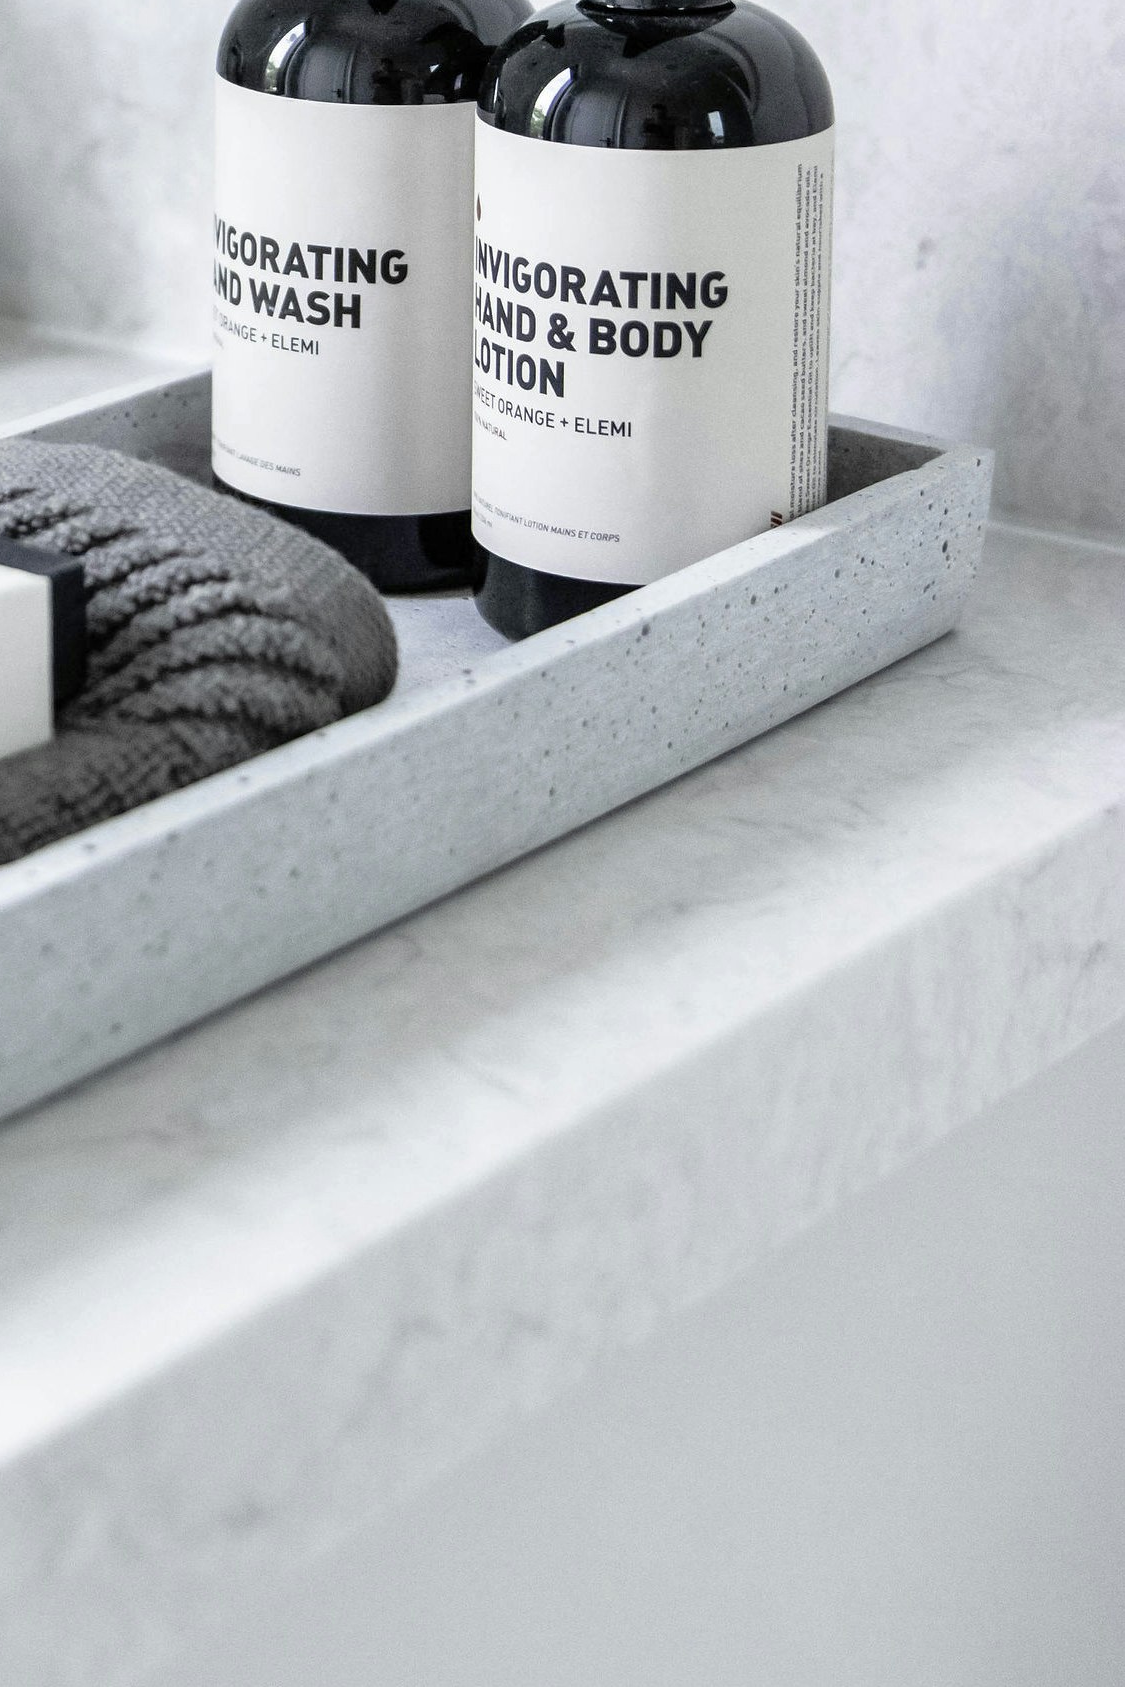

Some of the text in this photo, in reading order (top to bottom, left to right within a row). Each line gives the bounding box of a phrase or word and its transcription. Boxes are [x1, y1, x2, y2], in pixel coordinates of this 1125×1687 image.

[213, 212, 408, 285] VIGORATING
[475, 235, 728, 309] INVIGORATING
[248, 277, 361, 329] WASH
[475, 282, 713, 358] HAND & BODY
[261, 333, 268, 342] +
[271, 333, 319, 355] ELEMI
[474, 329, 565, 398] LOTION
[498, 397, 555, 428] ORANGE
[560, 417, 569, 427] +
[574, 417, 631, 437] ELEMI
[275, 464, 301, 476] MAINS
[523, 518, 549, 532] LOTION
[550, 526, 576, 537] MAINS
[577, 530, 589, 539] ET
[590, 532, 620, 543] CORPS
